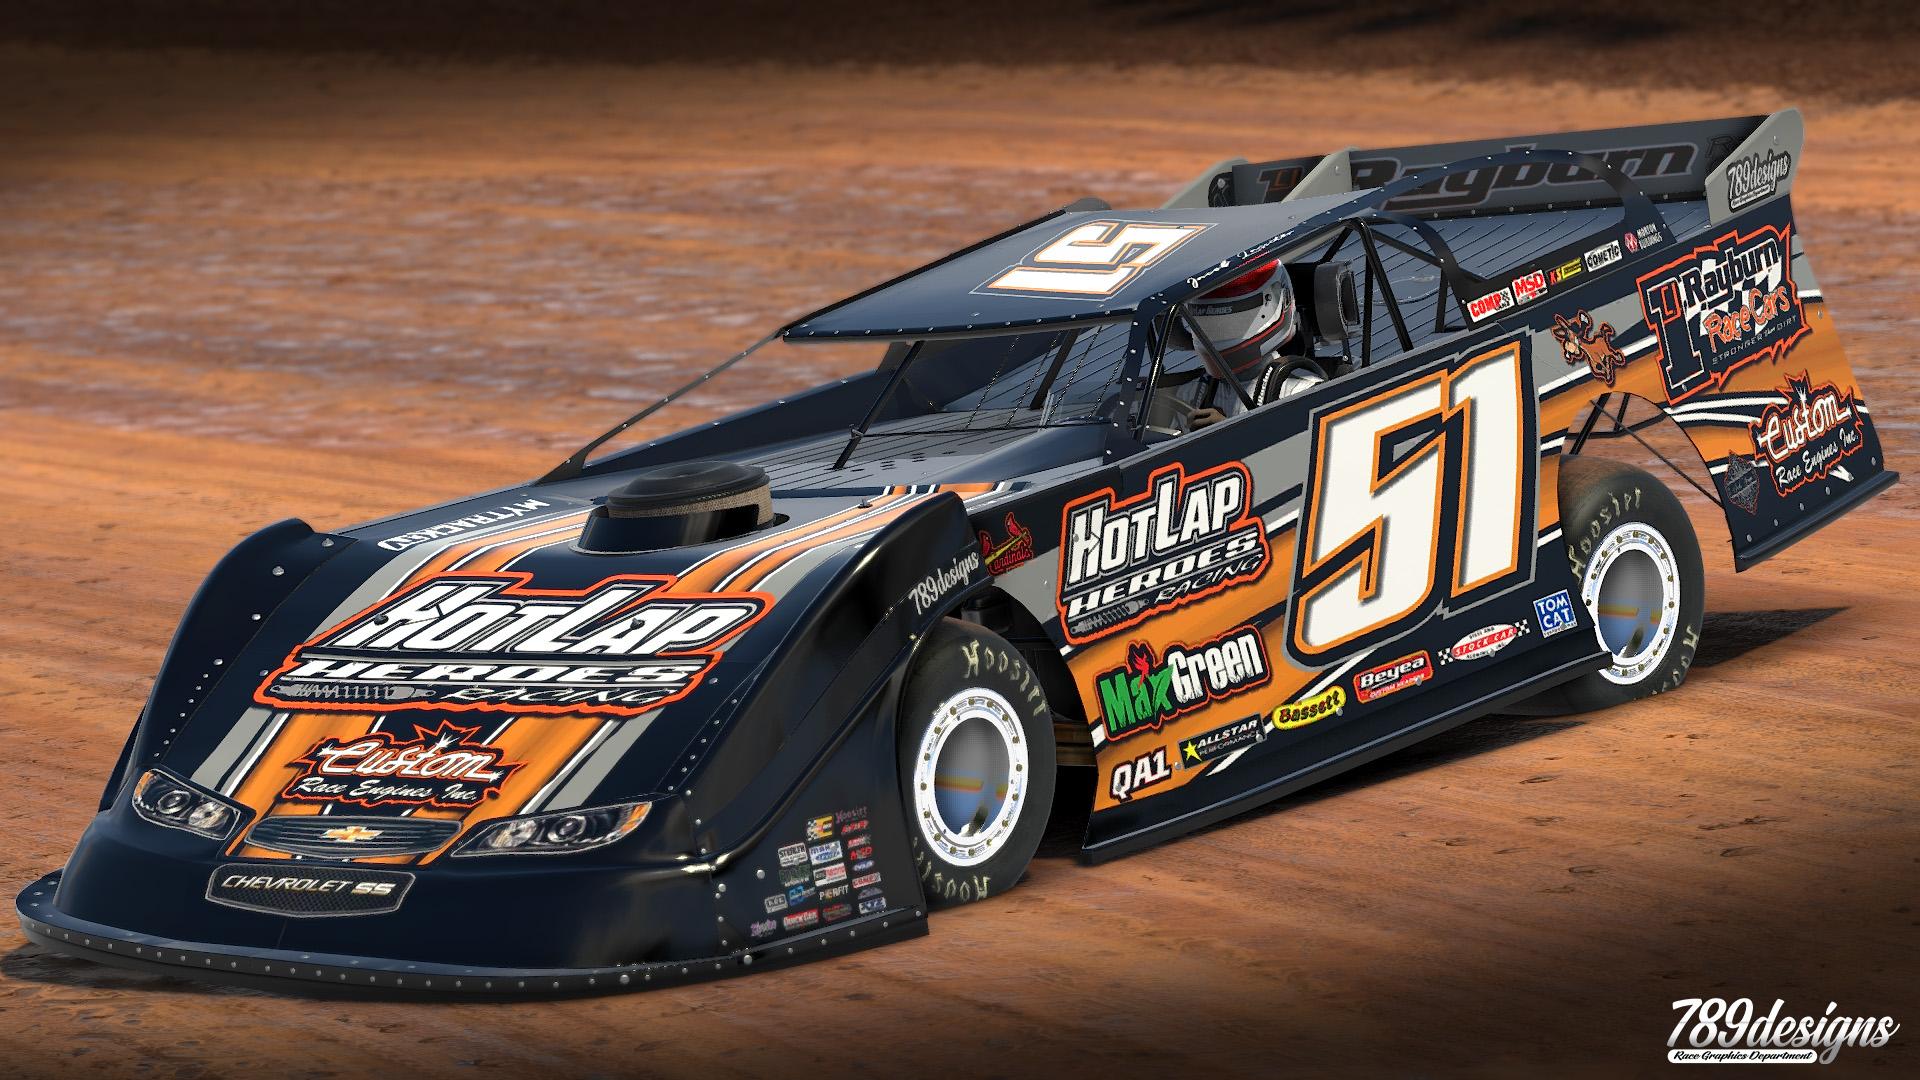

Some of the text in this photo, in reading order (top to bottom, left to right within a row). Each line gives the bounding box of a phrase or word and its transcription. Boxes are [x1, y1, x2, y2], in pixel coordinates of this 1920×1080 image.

[1727, 153, 1788, 200] 789designs
[1587, 244, 1621, 268] COMETIC
[1514, 273, 1545, 296] MSD
[1680, 238, 1780, 310] Rayburn
[1470, 292, 1503, 318] COMP
[1757, 387, 1853, 461] Custom
[1775, 465, 1801, 488] Race
[1802, 442, 1839, 473] Engines
[1296, 342, 1523, 653] 51
[908, 552, 980, 616] 789designs
[1067, 532, 1258, 618] HEROES
[1154, 554, 1264, 605] RACING
[1537, 594, 1569, 613] TOM
[1543, 609, 1572, 630] CAT
[1454, 628, 1514, 656] STOCK CAR
[297, 660, 692, 684] HEROES
[1360, 657, 1425, 690] Beyea
[447, 686, 677, 705] RACING
[1277, 688, 1342, 725] Bassett
[1197, 719, 1258, 749] ALLSTAR
[317, 733, 503, 783] Custom
[1112, 750, 1171, 799] QA1
[295, 777, 477, 801] Race Engines Inc.
[221, 875, 397, 896] CHEVROLET SS
